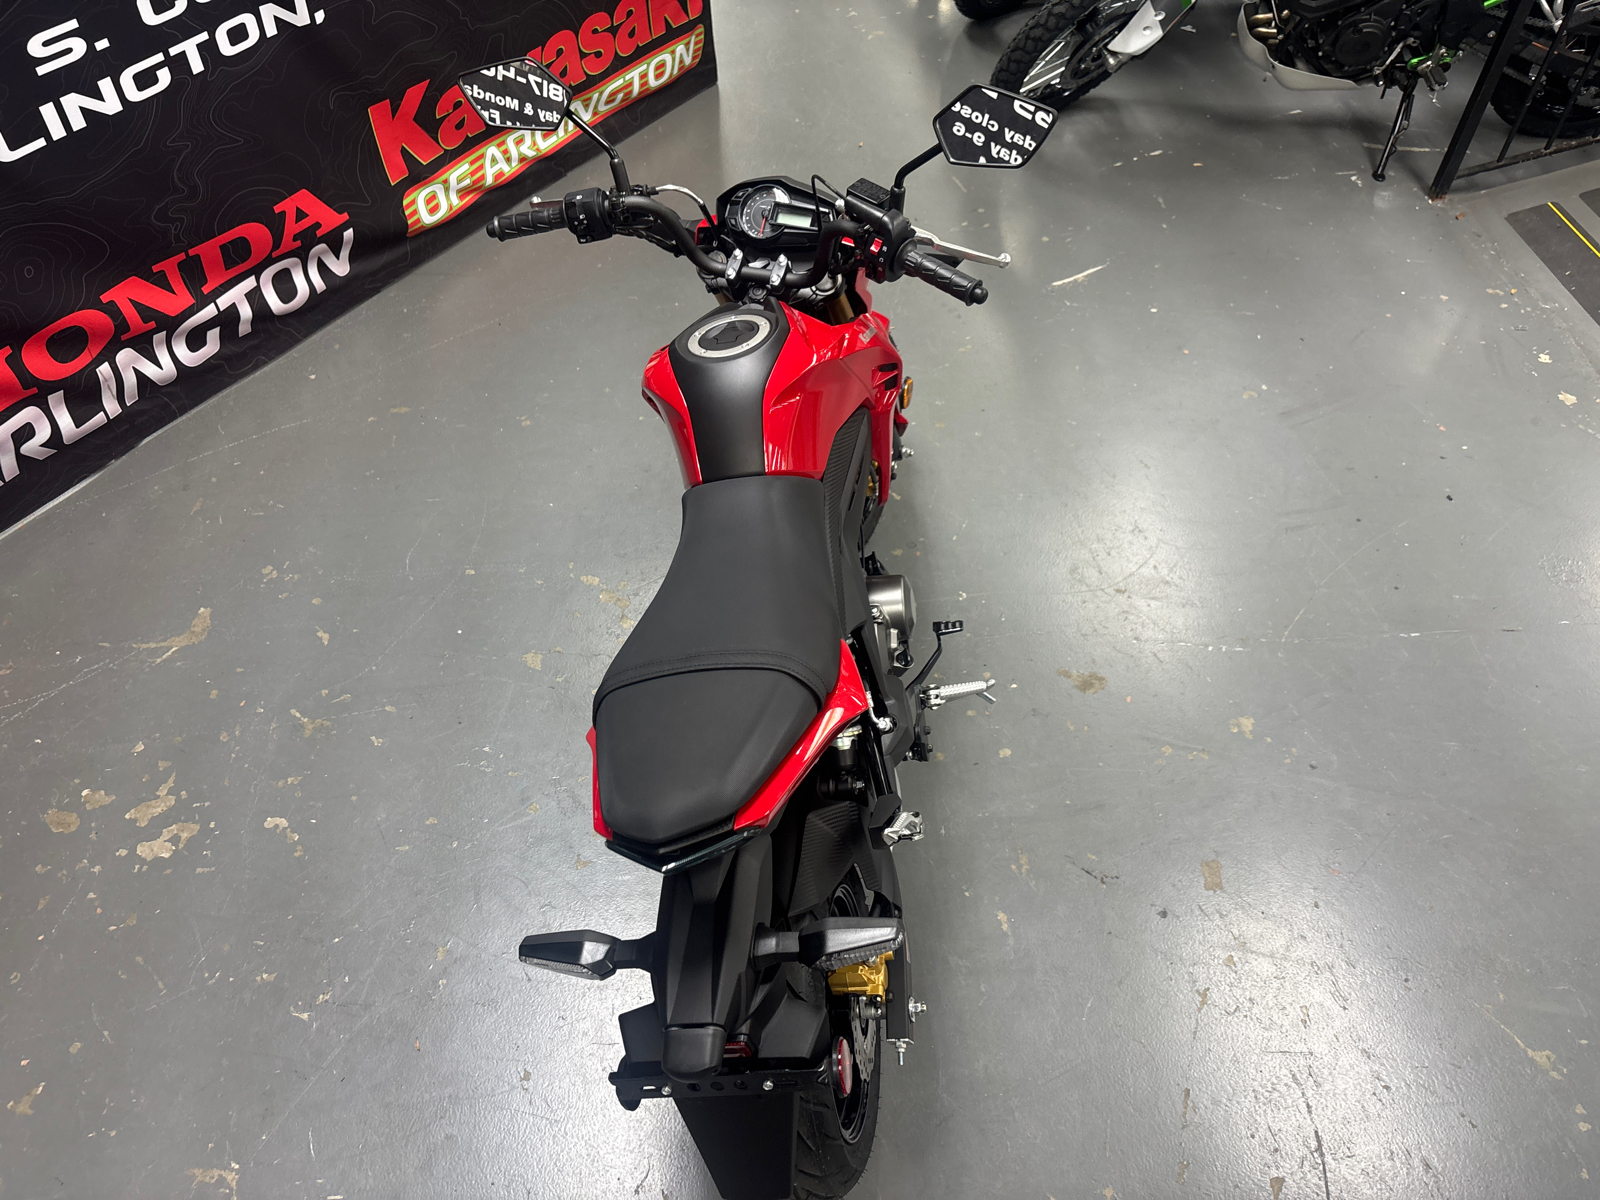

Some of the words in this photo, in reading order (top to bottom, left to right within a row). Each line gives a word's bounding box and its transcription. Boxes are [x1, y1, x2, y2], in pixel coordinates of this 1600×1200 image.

[27, 18, 110, 77] S.
[417, 162, 472, 226] OF
[0, 227, 354, 486] RLINGTON
